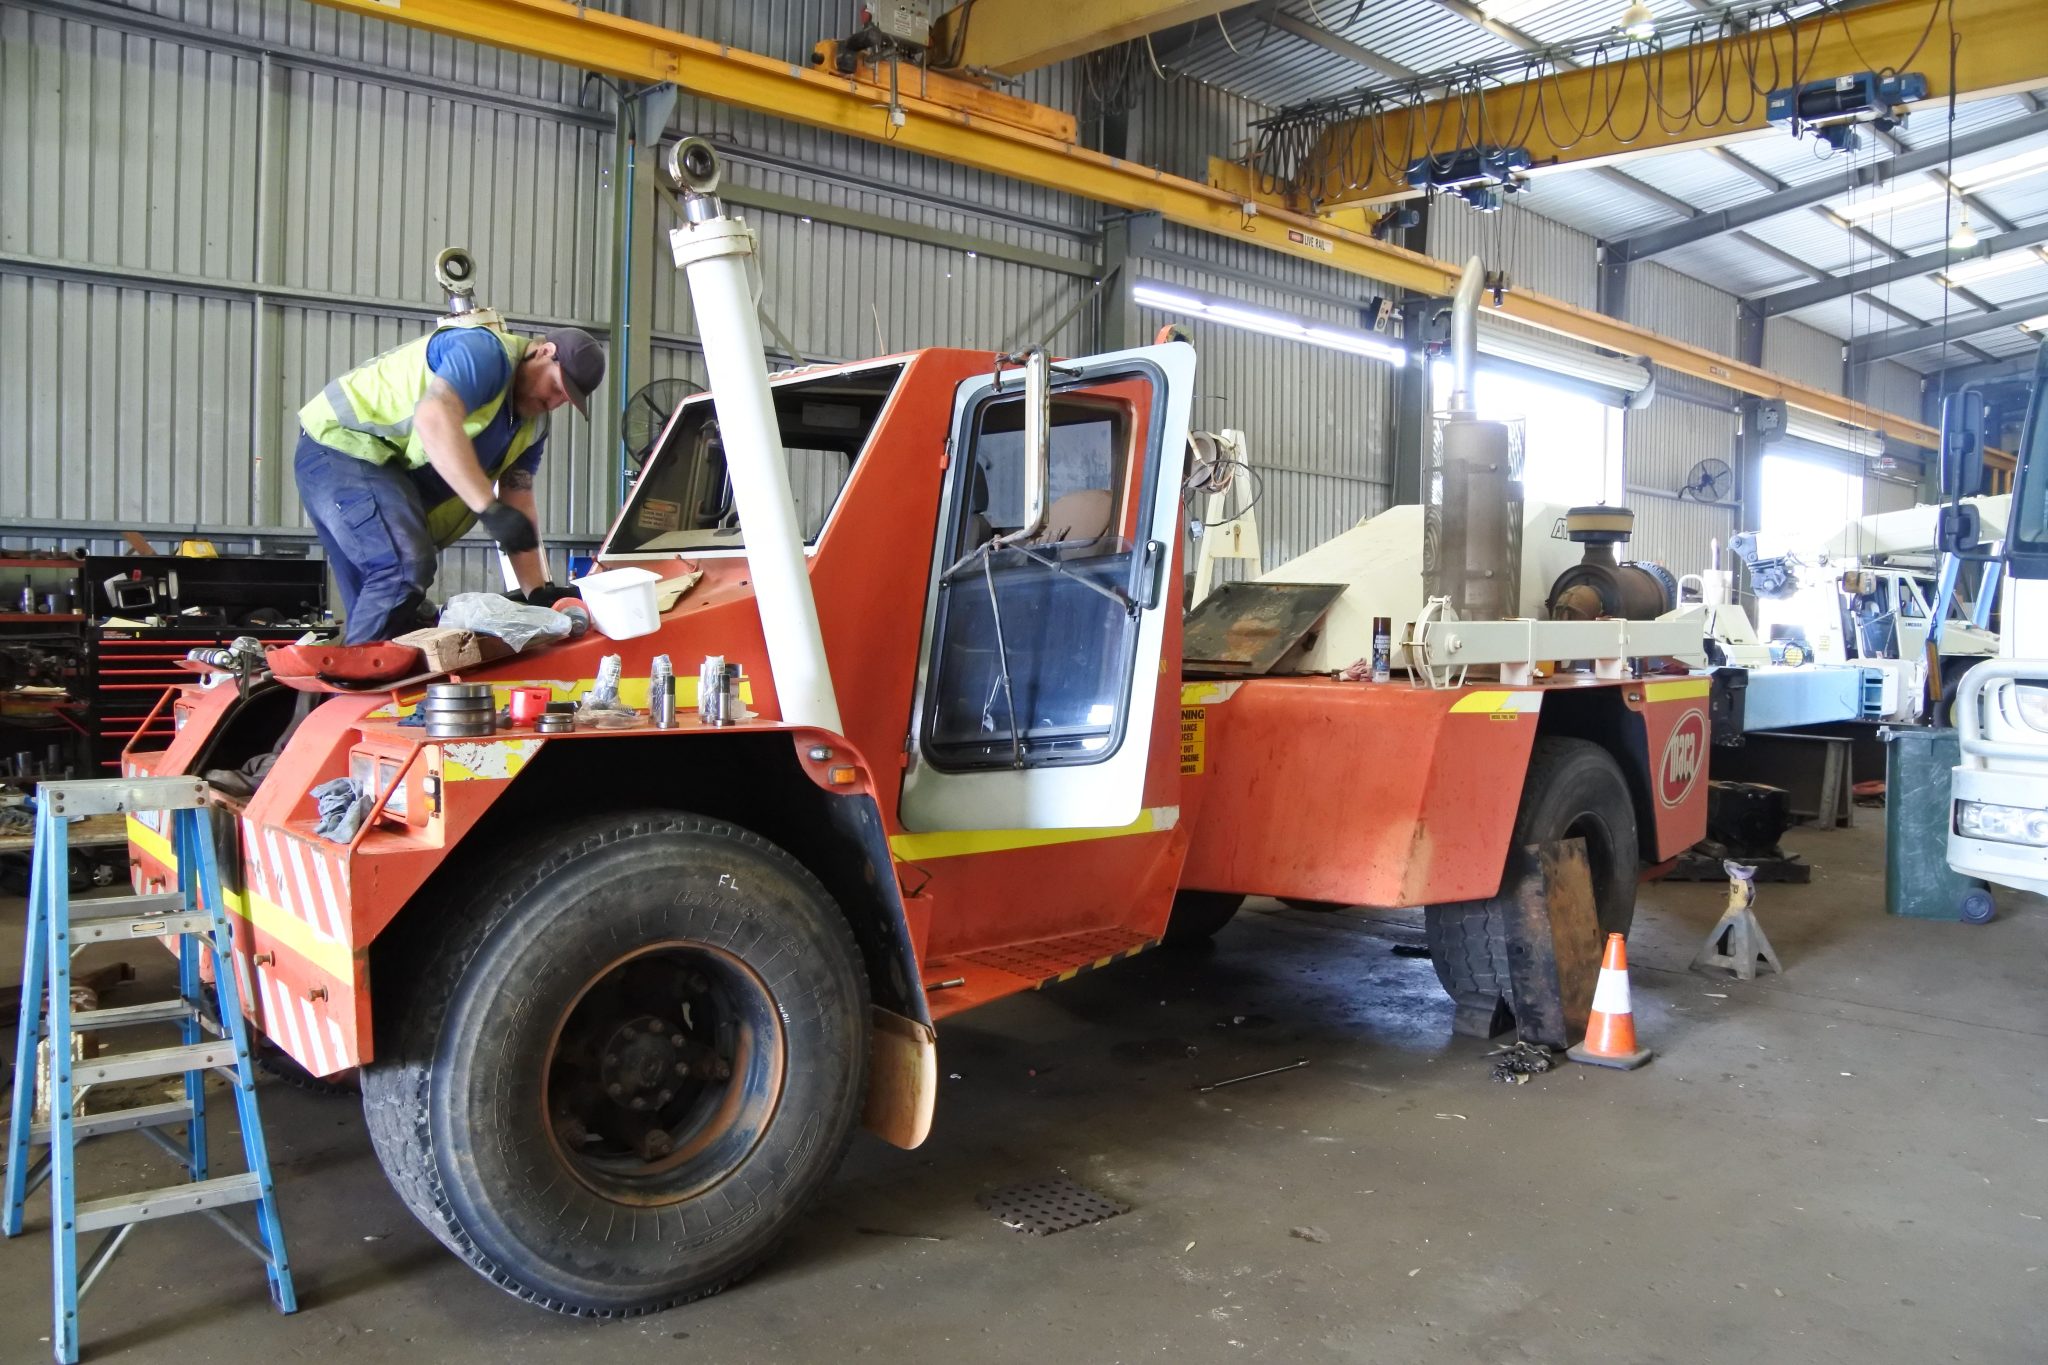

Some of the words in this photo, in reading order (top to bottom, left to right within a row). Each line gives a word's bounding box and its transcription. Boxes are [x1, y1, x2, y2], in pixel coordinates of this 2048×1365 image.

[1304, 235, 1314, 247] LIVE
[1315, 238, 1325, 250] RAIL
[1181, 710, 1204, 720] NING
[1181, 724, 1197, 732] ANCE
[718, 873, 739, 891] FL
